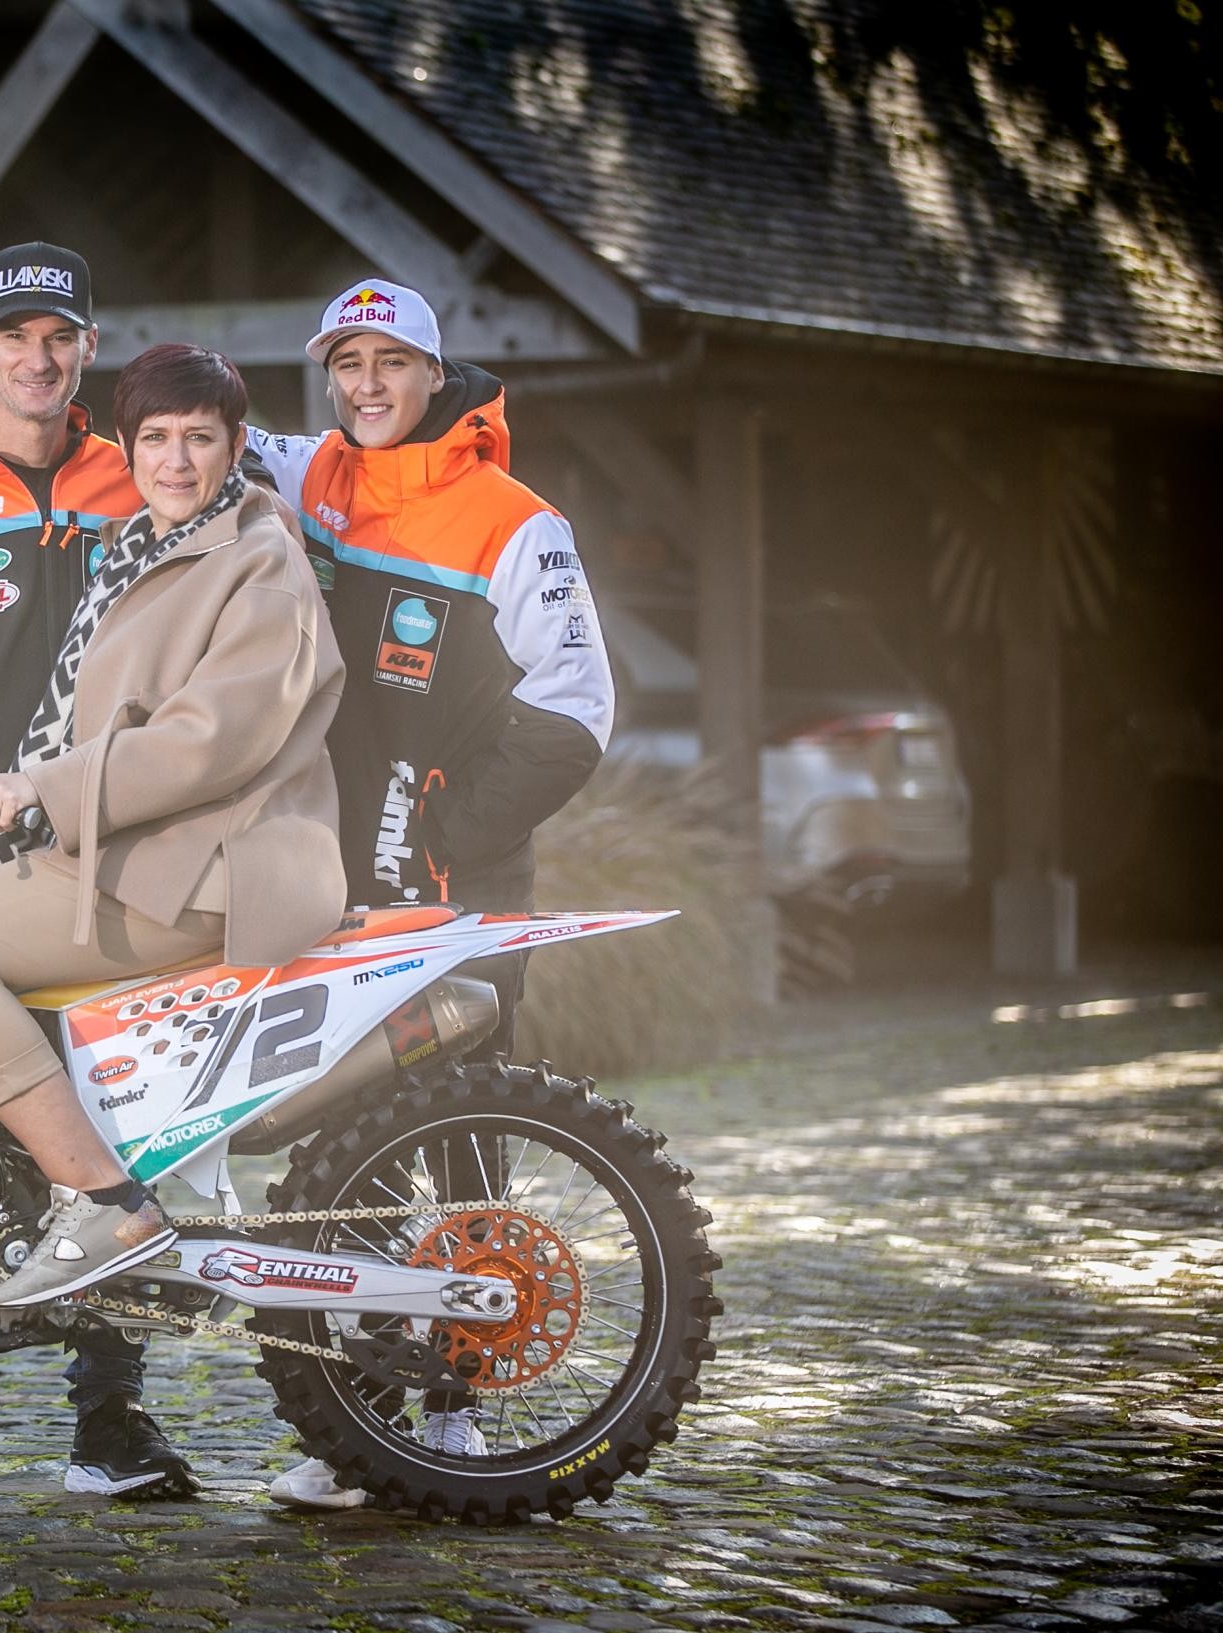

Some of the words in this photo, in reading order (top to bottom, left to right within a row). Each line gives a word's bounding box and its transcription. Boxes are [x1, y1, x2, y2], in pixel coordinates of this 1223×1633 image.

[338, 308, 364, 325] Red
[365, 308, 396, 324] Bull
[386, 651, 425, 671] KTM
[376, 670, 403, 683] LIAMSKI
[402, 676, 428, 689] RACING
[528, 925, 583, 941] MAXXIS
[101, 990, 133, 1009] LIAM
[92, 1067, 119, 1082] Twin
[117, 1059, 137, 1073] Air
[150, 1113, 226, 1153] MOTOREX
[549, 1438, 611, 1480] MAXXIS
